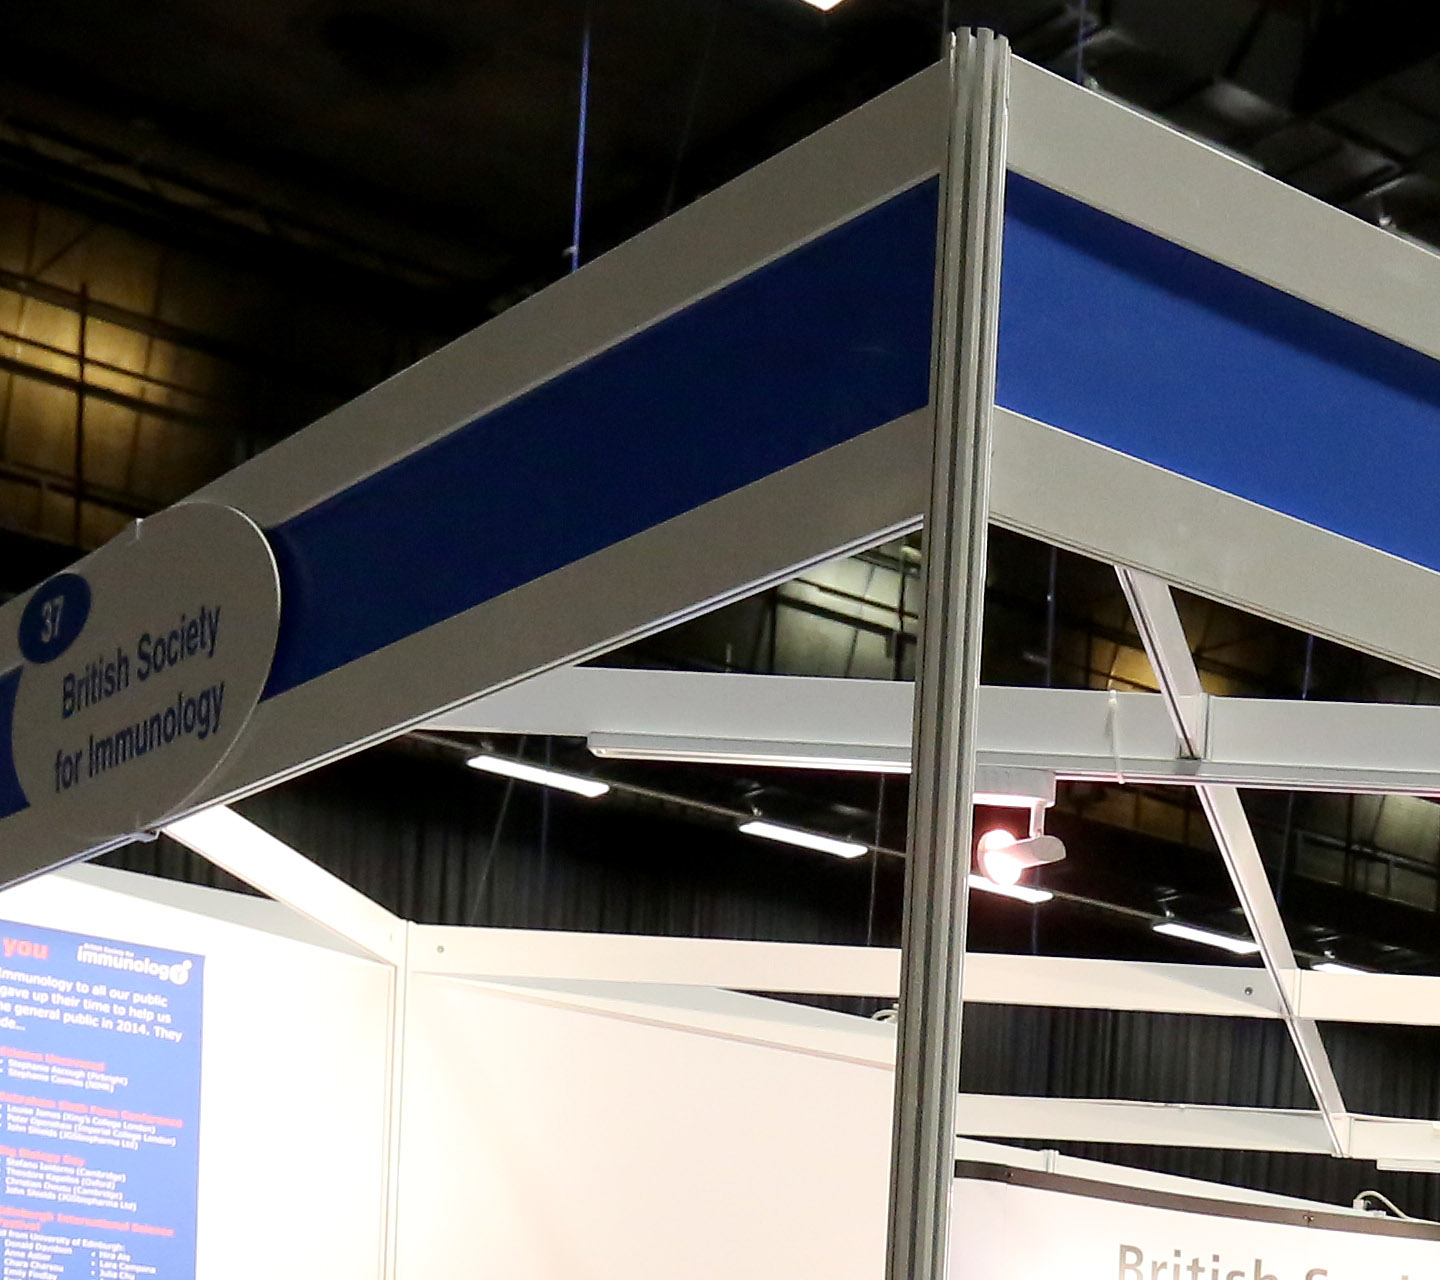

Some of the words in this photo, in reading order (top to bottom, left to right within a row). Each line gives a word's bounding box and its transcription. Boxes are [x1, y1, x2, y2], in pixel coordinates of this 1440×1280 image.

[41, 596, 64, 644] 37
[62, 648, 129, 719] British
[137, 606, 220, 682] Society
[55, 750, 82, 792] for
[89, 681, 224, 778] Immunology
[3, 937, 49, 960] you
[0, 985, 29, 1000] gave
[32, 991, 48, 1004] up
[51, 990, 80, 1006] their
[83, 997, 110, 1011] time
[113, 1003, 126, 1015] to
[129, 1004, 154, 1022] help
[157, 1012, 171, 1023] us
[77, 981, 89, 994] to
[92, 984, 106, 996] all
[110, 989, 130, 1000] our
[133, 991, 168, 1007] public
[14, 1003, 60, 1020] general
[63, 1010, 99, 1028] public
[102, 1016, 113, 1028] in
[117, 1020, 149, 1036] 2014.
[154, 1026, 182, 1042] They
